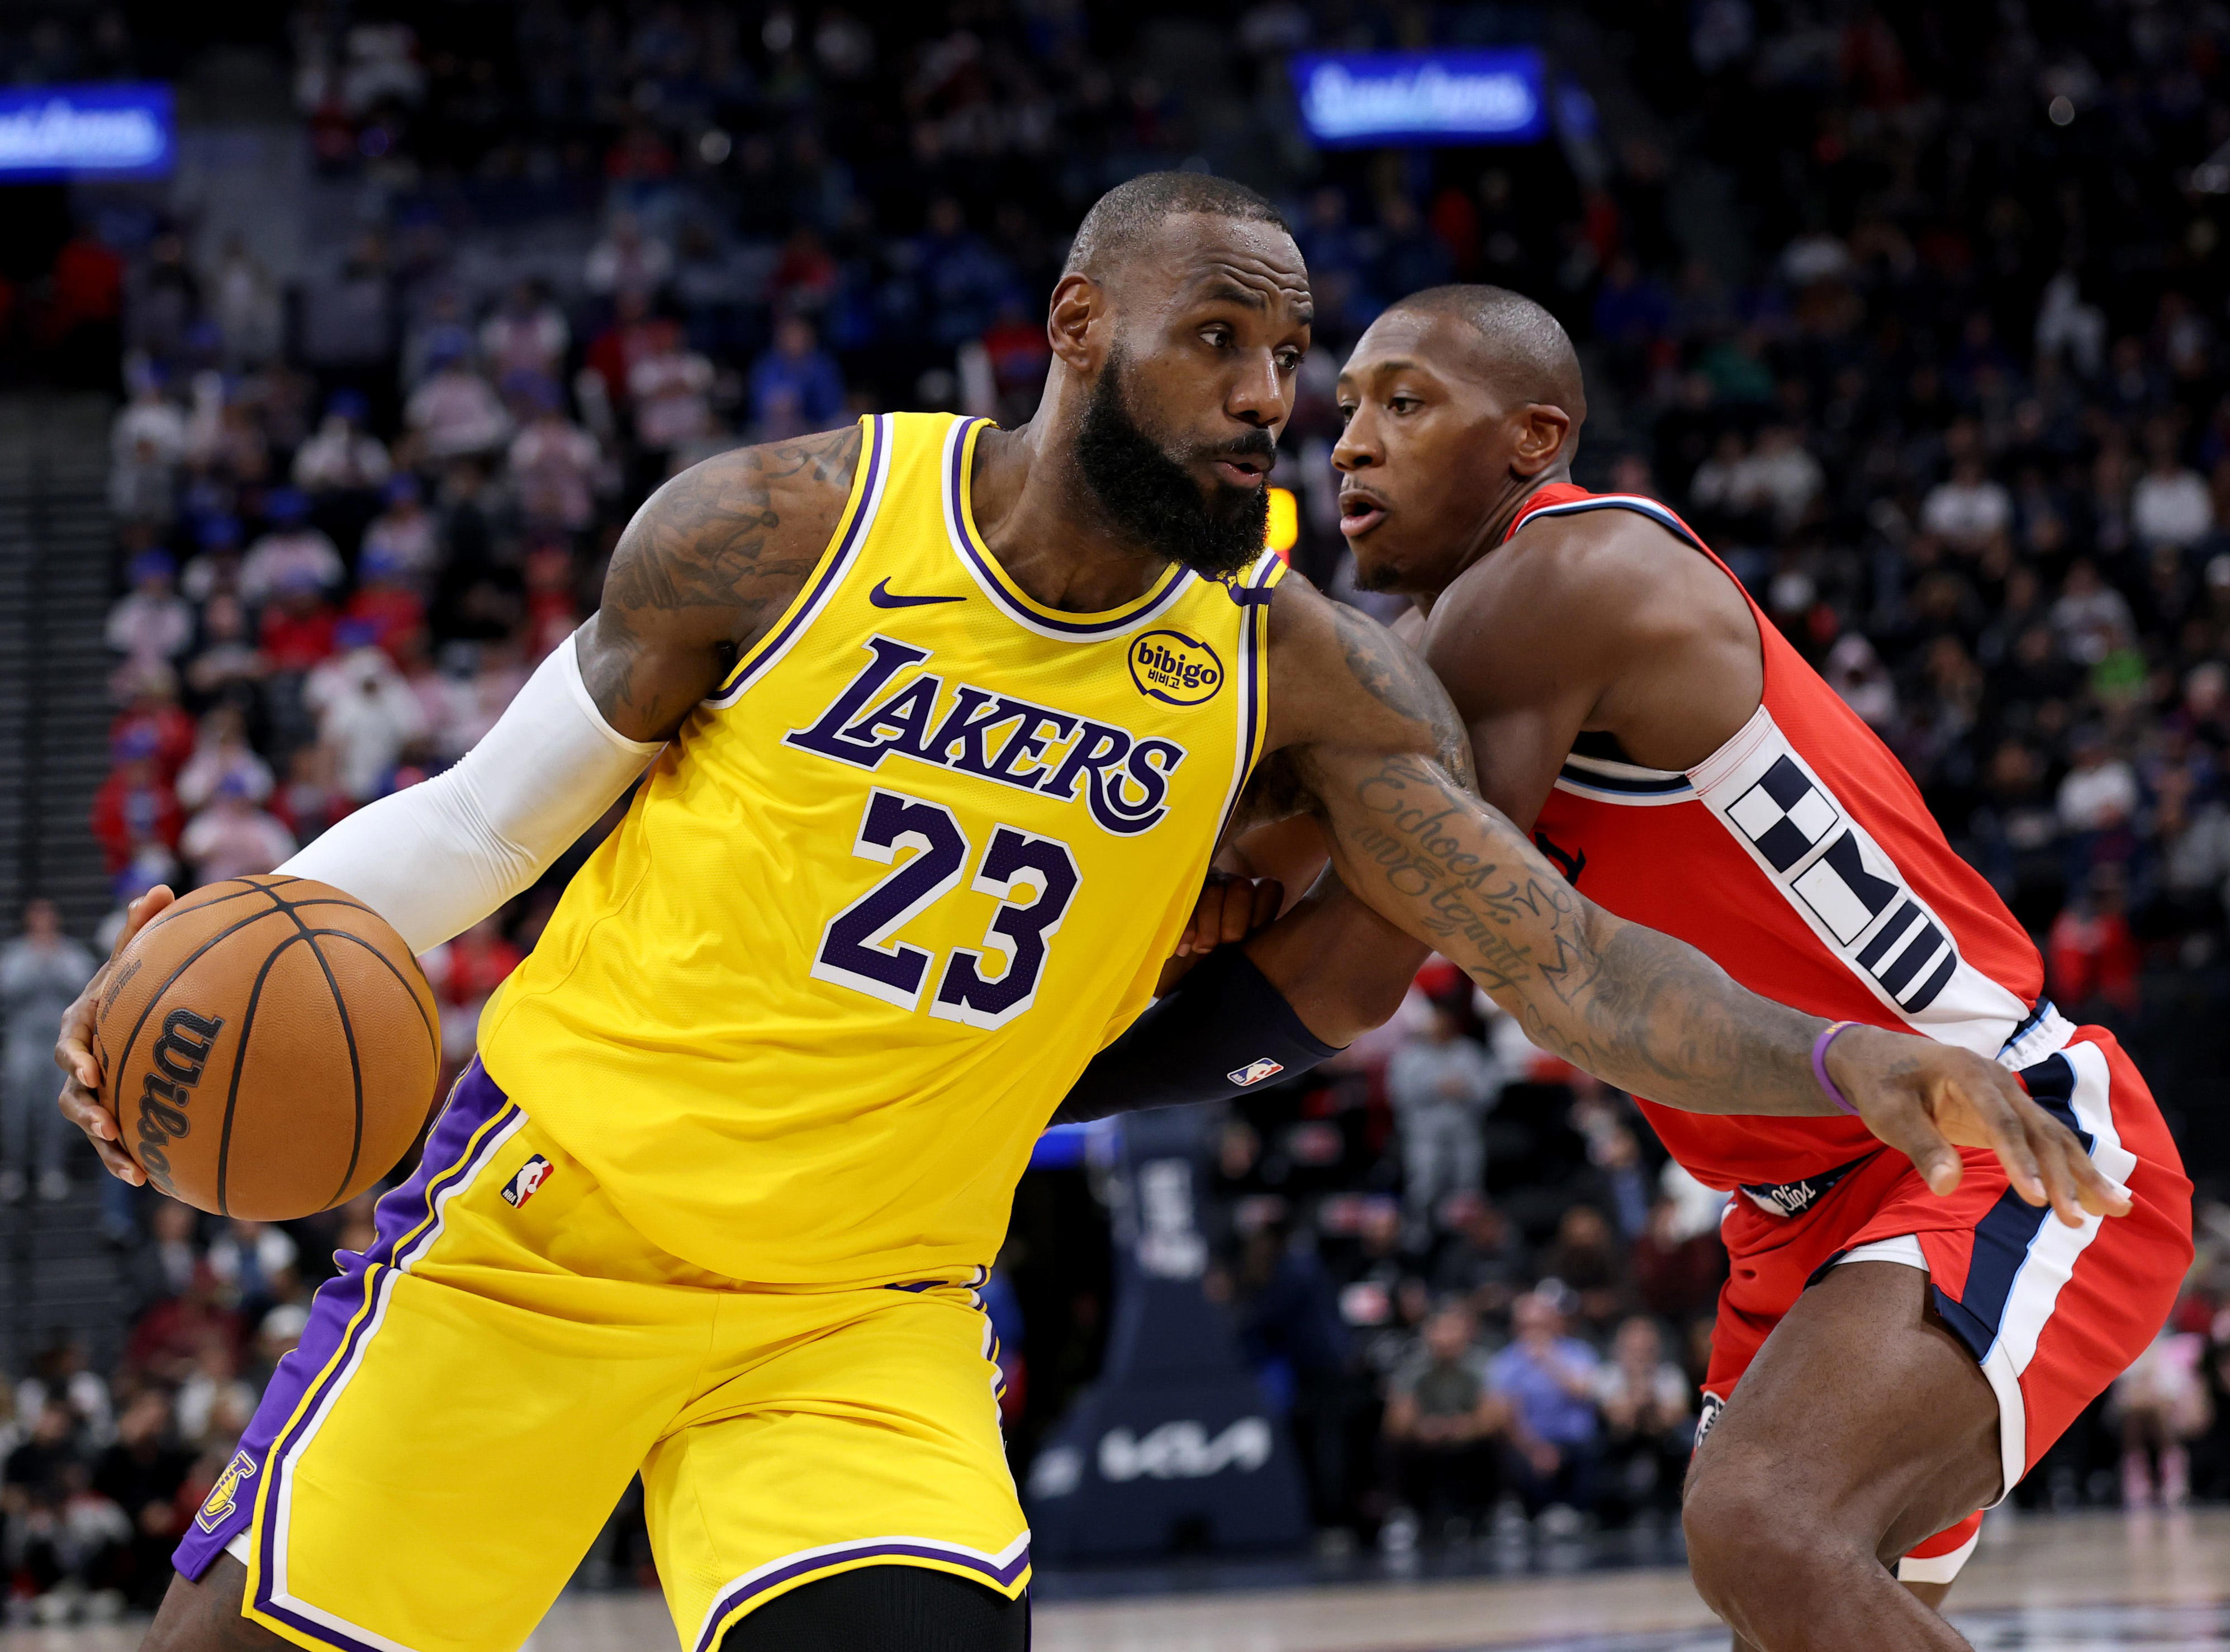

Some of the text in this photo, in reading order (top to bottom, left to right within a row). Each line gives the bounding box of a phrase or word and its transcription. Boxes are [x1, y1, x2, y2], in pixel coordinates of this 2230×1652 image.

[1138, 642, 1217, 688] bibigo
[1147, 668, 1180, 690] 비비고
[781, 632, 1190, 837] LAKERS
[810, 785, 1083, 1031] 23
[502, 1188, 517, 1204] NBA
